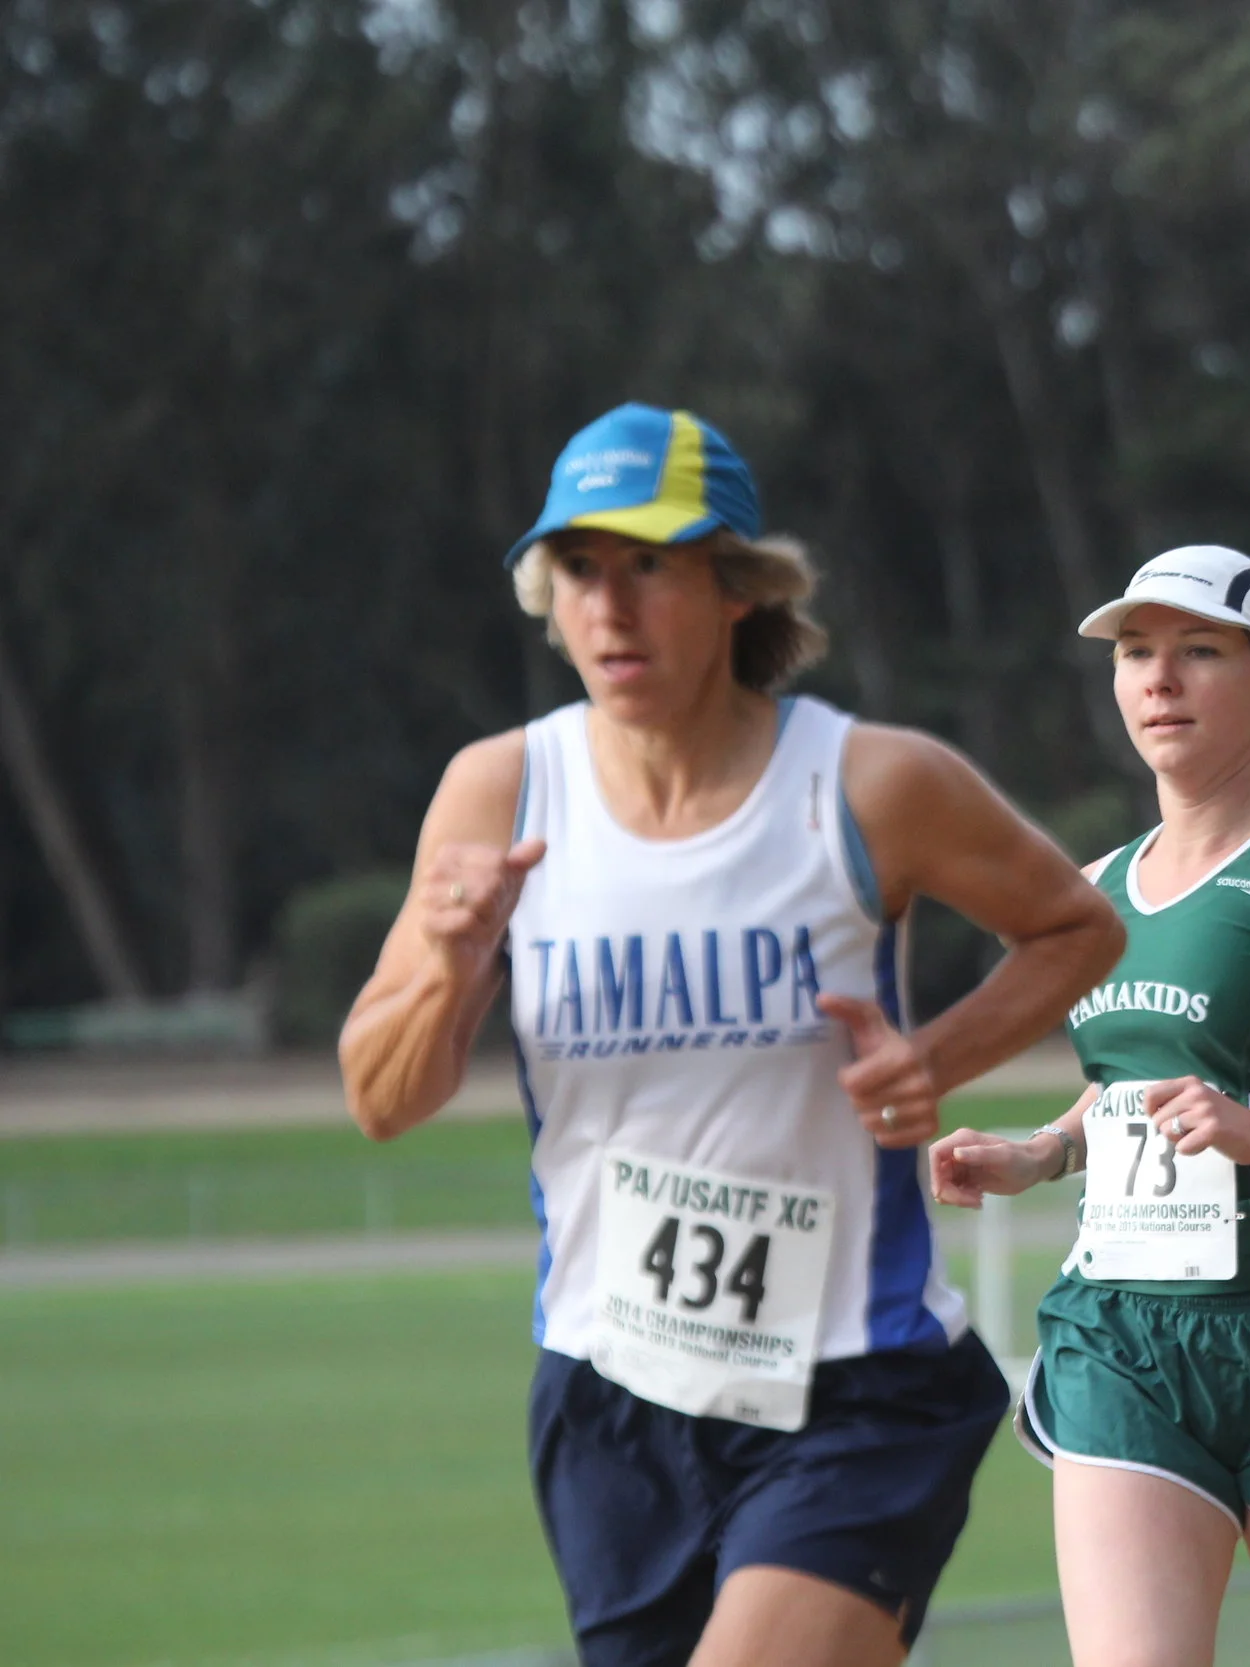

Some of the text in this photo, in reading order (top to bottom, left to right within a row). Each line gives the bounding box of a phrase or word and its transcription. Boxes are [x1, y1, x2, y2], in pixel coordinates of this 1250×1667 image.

[529, 926, 829, 1036] TAMALPA
[1069, 981, 1211, 1029] PAMAKIDS
[567, 1029, 782, 1061] RUNNERS
[1125, 1123, 1177, 1197] 73
[614, 1161, 819, 1232] PA/USATF XC
[1090, 1203, 1221, 1219] 2014 CHAMPIONSHIPS
[1119, 1222, 1137, 1232] 2015
[1140, 1221, 1176, 1232] National
[1178, 1221, 1212, 1232] Course
[641, 1215, 771, 1325] 434
[606, 1295, 795, 1357] 2014 CHAMPIONSHIPS
[647, 1330, 675, 1349] 2015
[678, 1338, 729, 1363] National
[732, 1350, 778, 1370] Course
